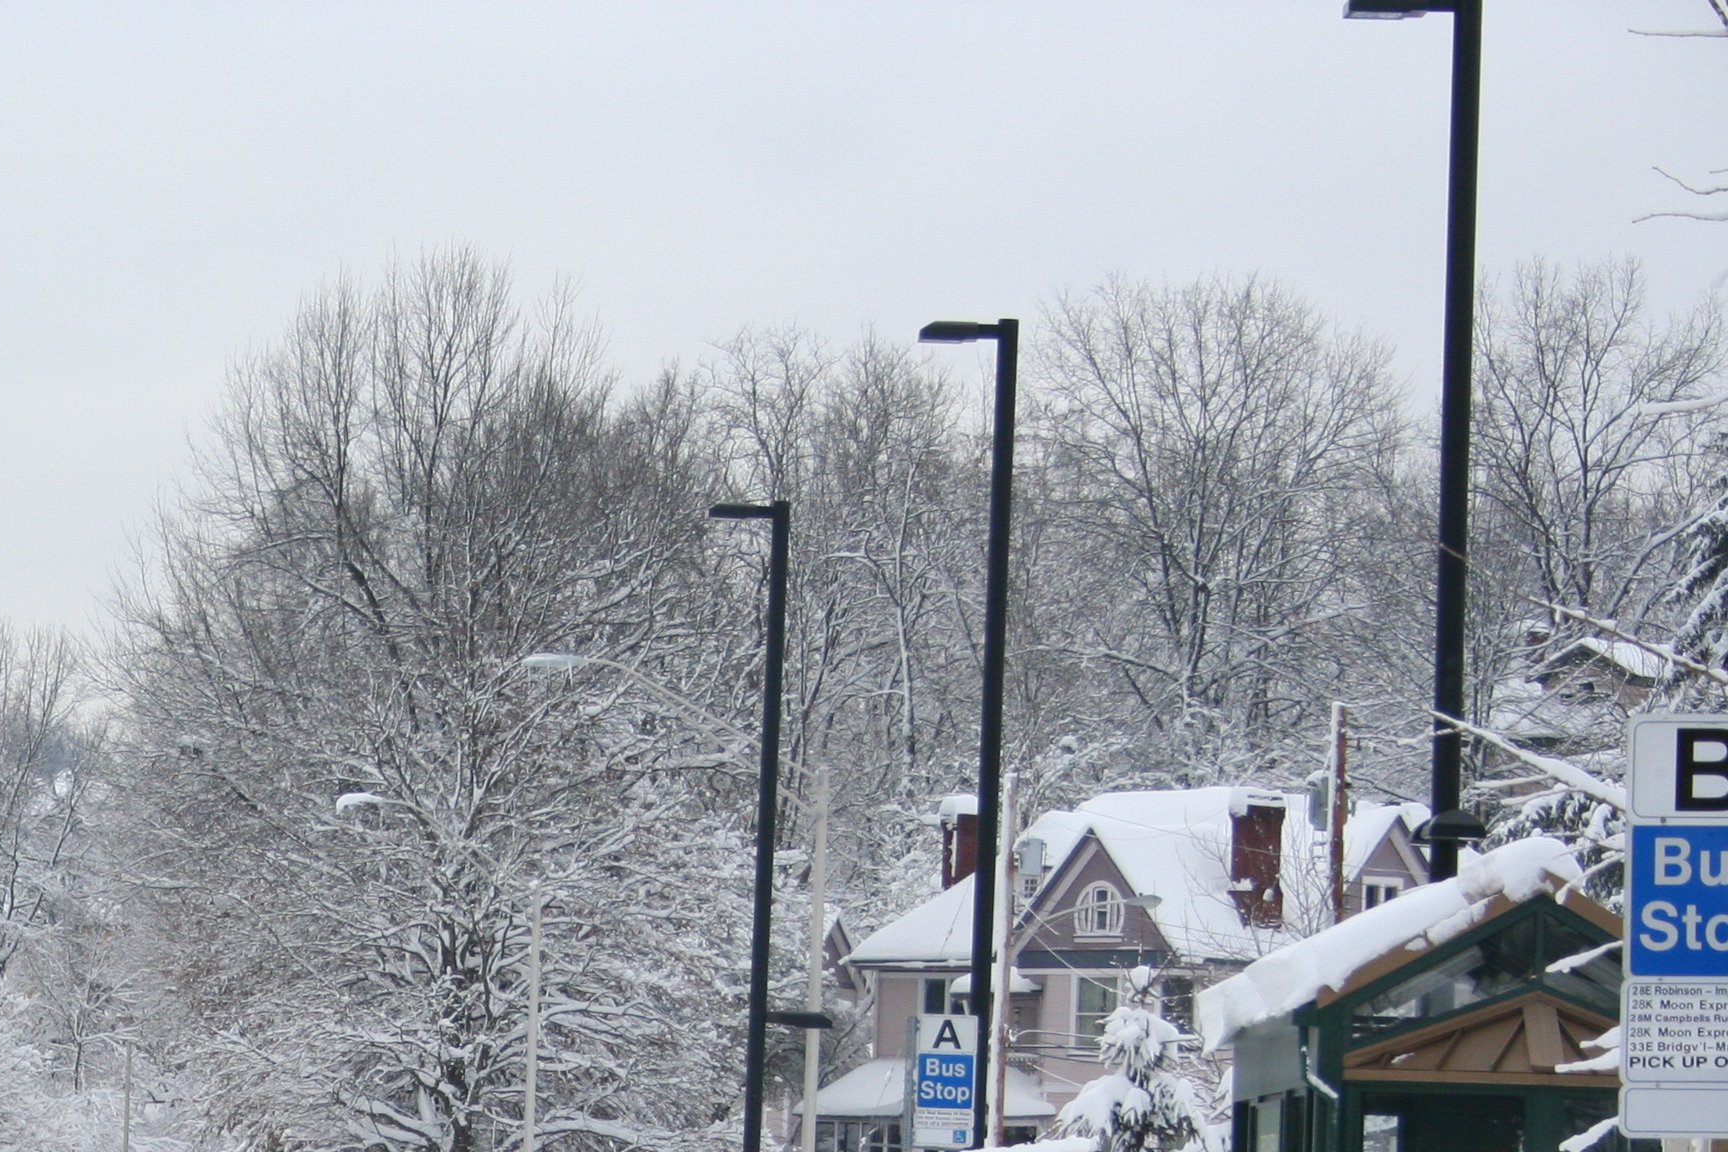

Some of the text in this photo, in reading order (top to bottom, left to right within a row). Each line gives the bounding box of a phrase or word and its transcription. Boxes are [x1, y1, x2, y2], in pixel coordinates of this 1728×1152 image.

[1675, 727, 1728, 811] B
[1632, 986, 1652, 996] 28E
[1654, 986, 1703, 996] Robinson
[1715, 986, 1728, 997] Im
[1631, 1000, 1653, 1010] 28K
[1659, 1000, 1694, 1010] Moon
[1630, 1013, 1652, 1023] 28M
[1654, 1013, 1711, 1025] Campbells
[932, 1019, 962, 1050] A
[1629, 1027, 1652, 1038] 28K
[1658, 1027, 1692, 1038] Moon
[1629, 1042, 1653, 1052] 33E
[925, 1058, 966, 1078] Bus
[1629, 1056, 1675, 1069] PICK
[1682, 1056, 1708, 1069] UP
[920, 1081, 970, 1104] Stop
